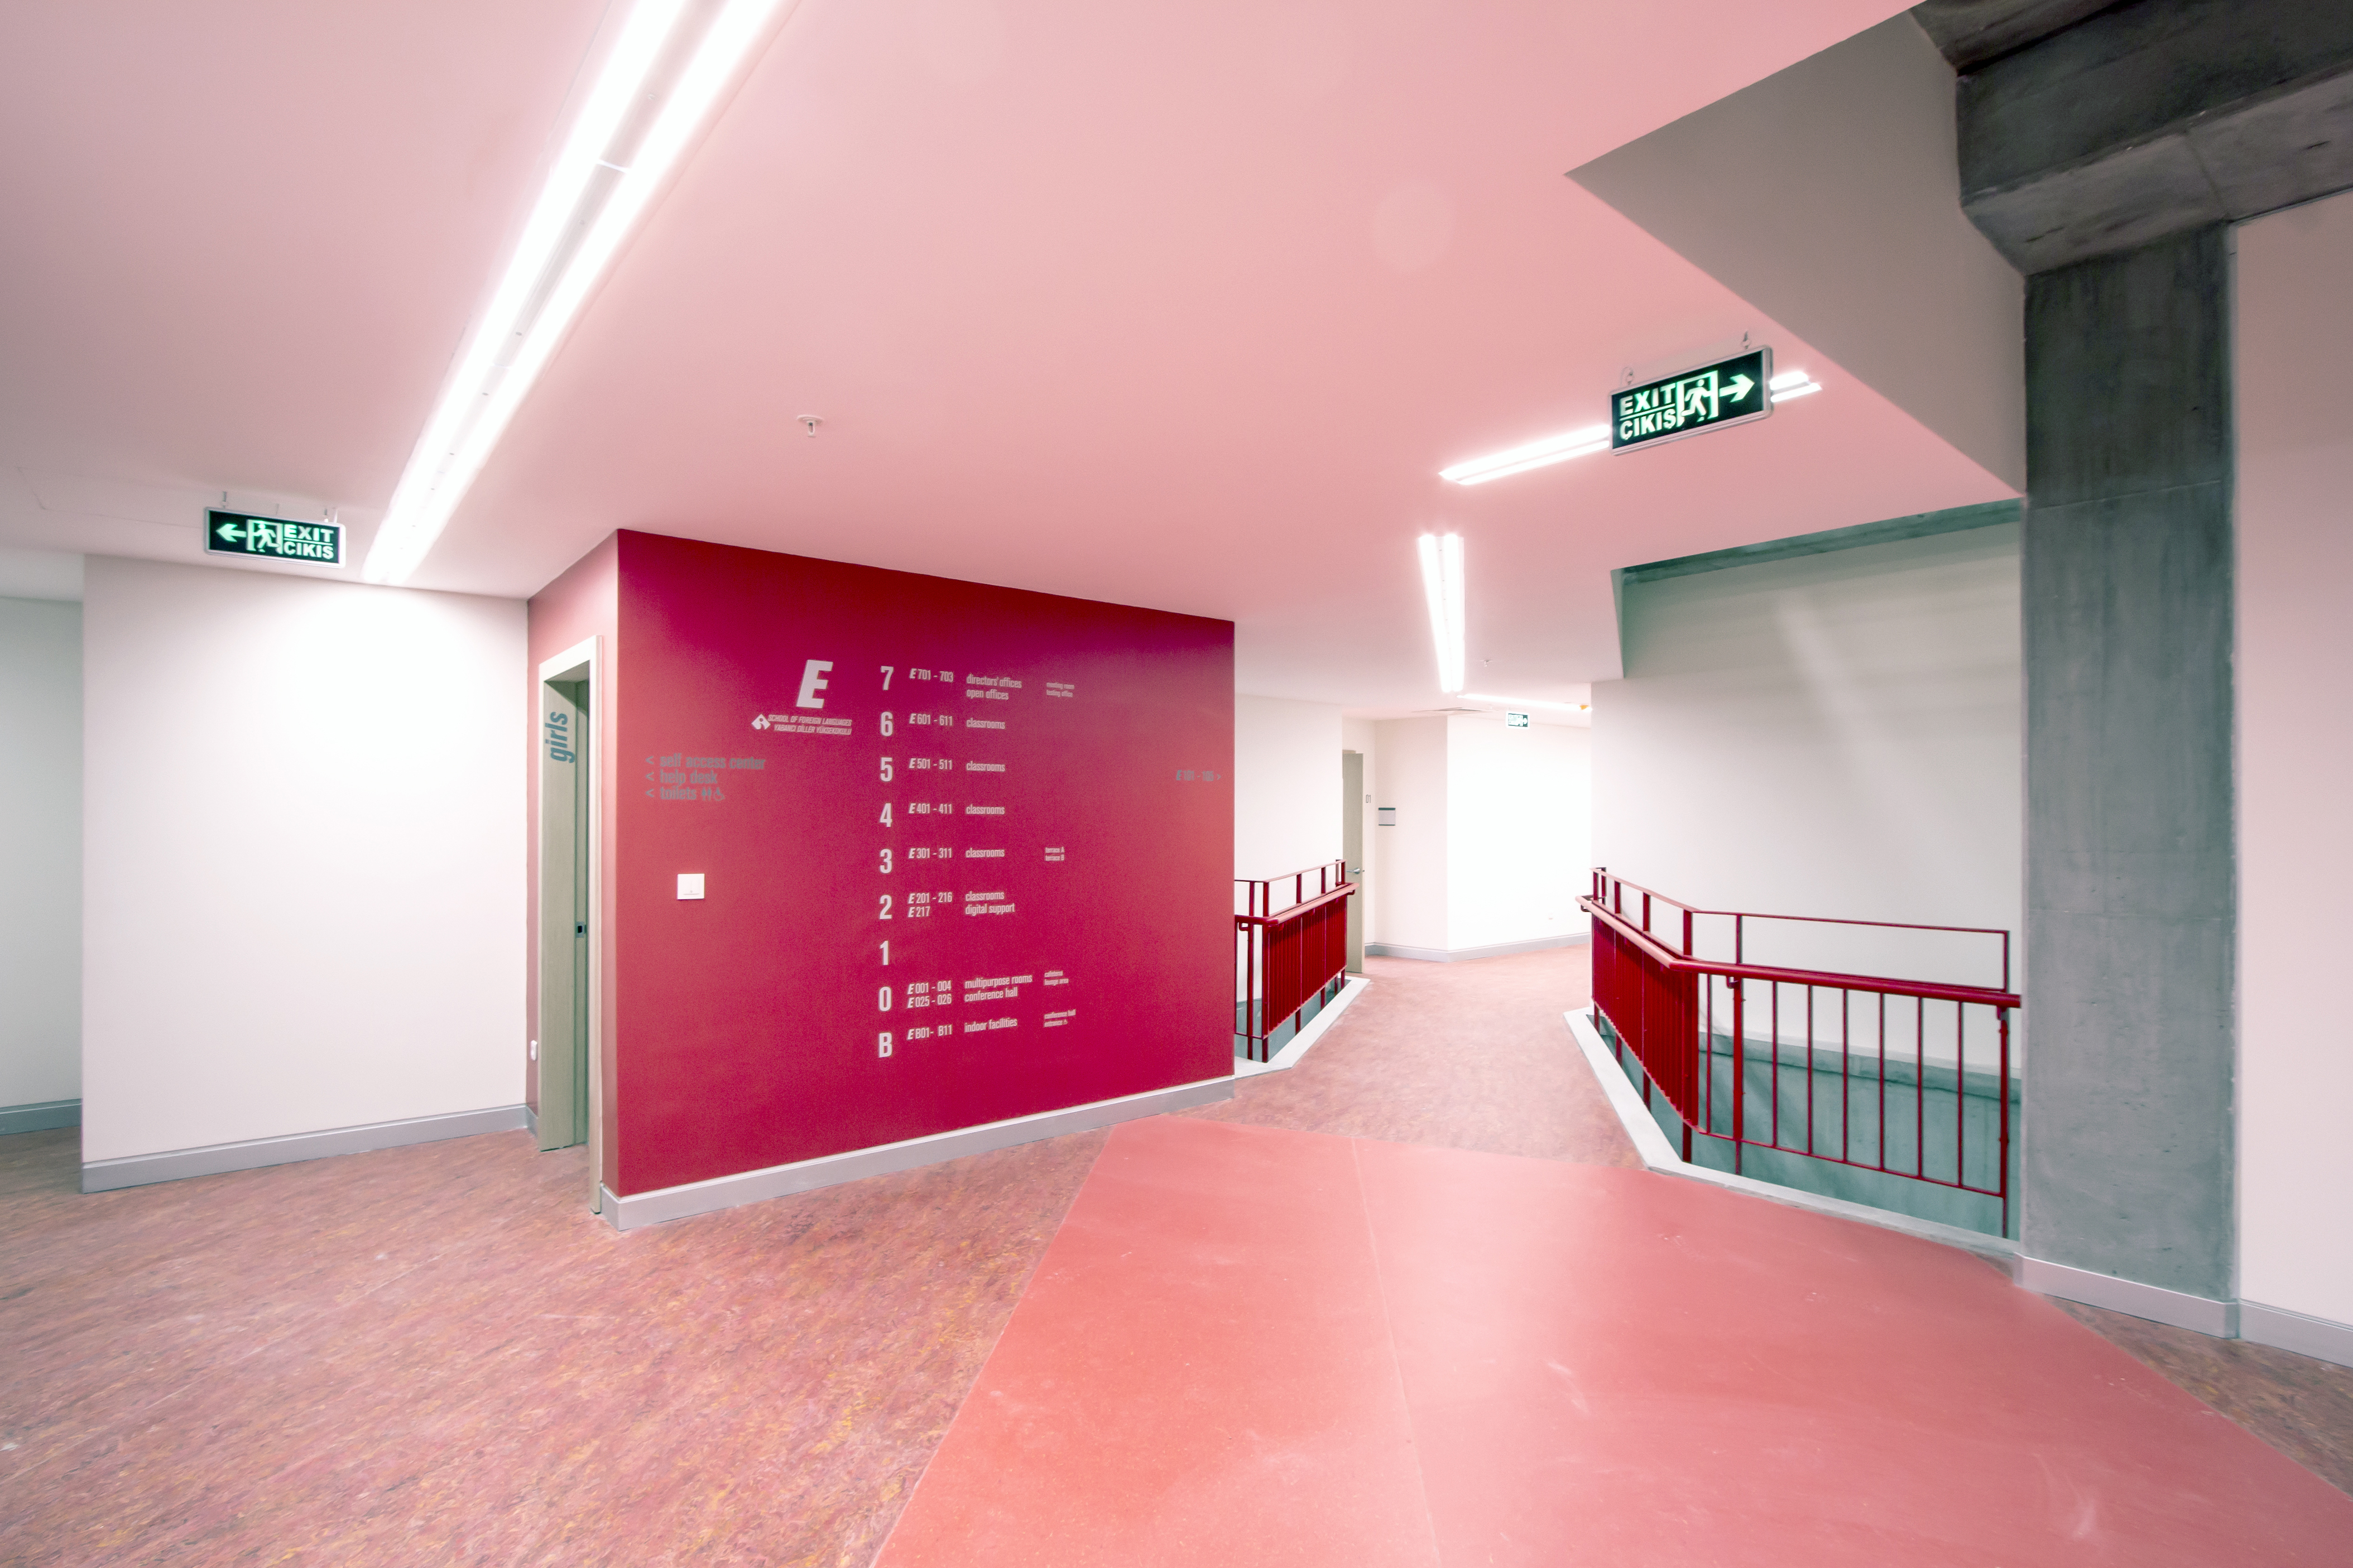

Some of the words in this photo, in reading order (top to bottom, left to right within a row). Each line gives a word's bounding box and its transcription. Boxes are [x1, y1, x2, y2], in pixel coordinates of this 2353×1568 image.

[1620, 383, 1676, 416] EXIT
[284, 524, 334, 542] EXIT
[880, 665, 894, 690] 7
[939, 671, 953, 682] 703
[1000, 677, 1022, 689] offices
[796, 660, 833, 709] E
[966, 689, 984, 699] open
[986, 689, 1009, 700] offices
[768, 714, 789, 723] SCHOOL
[799, 716, 822, 724] FOREIGN
[822, 718, 852, 727] LANGUAGES
[880, 711, 893, 736] 6
[939, 715, 953, 726] 611
[966, 718, 1005, 729] classrooms
[545, 711, 575, 764] girls
[660, 753, 681, 767] self
[685, 757, 726, 768] access
[729, 757, 766, 769] center
[939, 759, 953, 770] 511
[966, 761, 1005, 772] classrooms
[880, 757, 893, 782] 5
[660, 769, 686, 786] help
[690, 769, 717, 784] desk
[660, 785, 697, 800] toilets
[880, 802, 892, 828] 4
[939, 804, 952, 814] 411
[966, 804, 1005, 815] classrooms
[938, 848, 952, 859] 311
[966, 847, 1005, 858] classrooms
[880, 848, 892, 874] 3
[938, 892, 952, 903] 216
[966, 891, 1005, 901] classrooms
[880, 894, 892, 920] 2
[966, 903, 987, 916] digital
[988, 902, 1015, 915] support
[880, 940, 889, 966] 1
[938, 980, 951, 992] 004
[964, 977, 1010, 989] multipurpose
[1011, 975, 1033, 984] rooms
[938, 994, 952, 1006] 026
[964, 990, 1003, 1002] conference
[1005, 987, 1018, 998] hall
[938, 1025, 952, 1037] B11
[964, 1021, 987, 1033] indoor
[988, 1017, 1017, 1030] facilities
[878, 1032, 892, 1058] B
